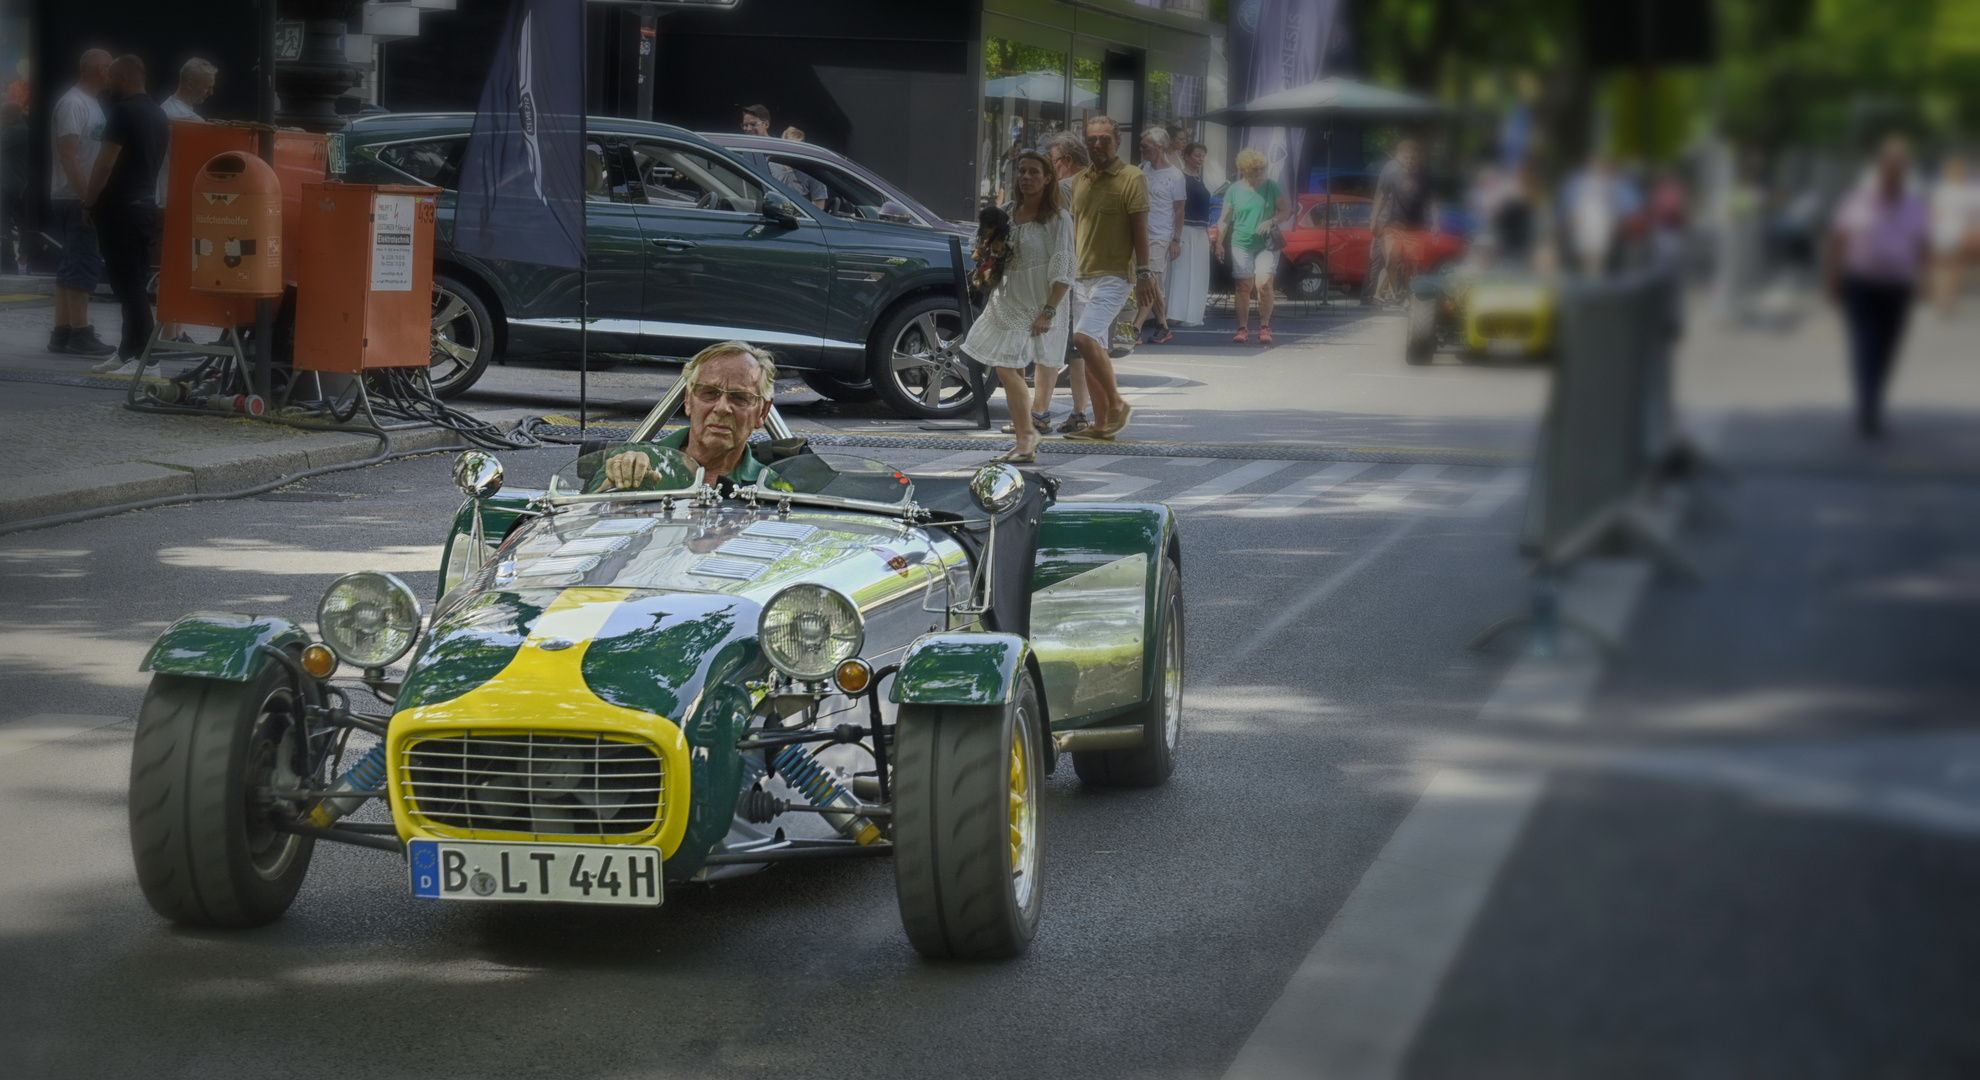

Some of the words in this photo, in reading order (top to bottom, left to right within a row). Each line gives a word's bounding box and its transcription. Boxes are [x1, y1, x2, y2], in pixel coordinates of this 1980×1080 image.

[418, 203, 435, 224] 433
[377, 235, 410, 244] Elektrotechnik
[420, 875, 432, 889] D
[442, 849, 468, 893] B
[501, 851, 556, 895] LT
[569, 853, 655, 898] 44H
